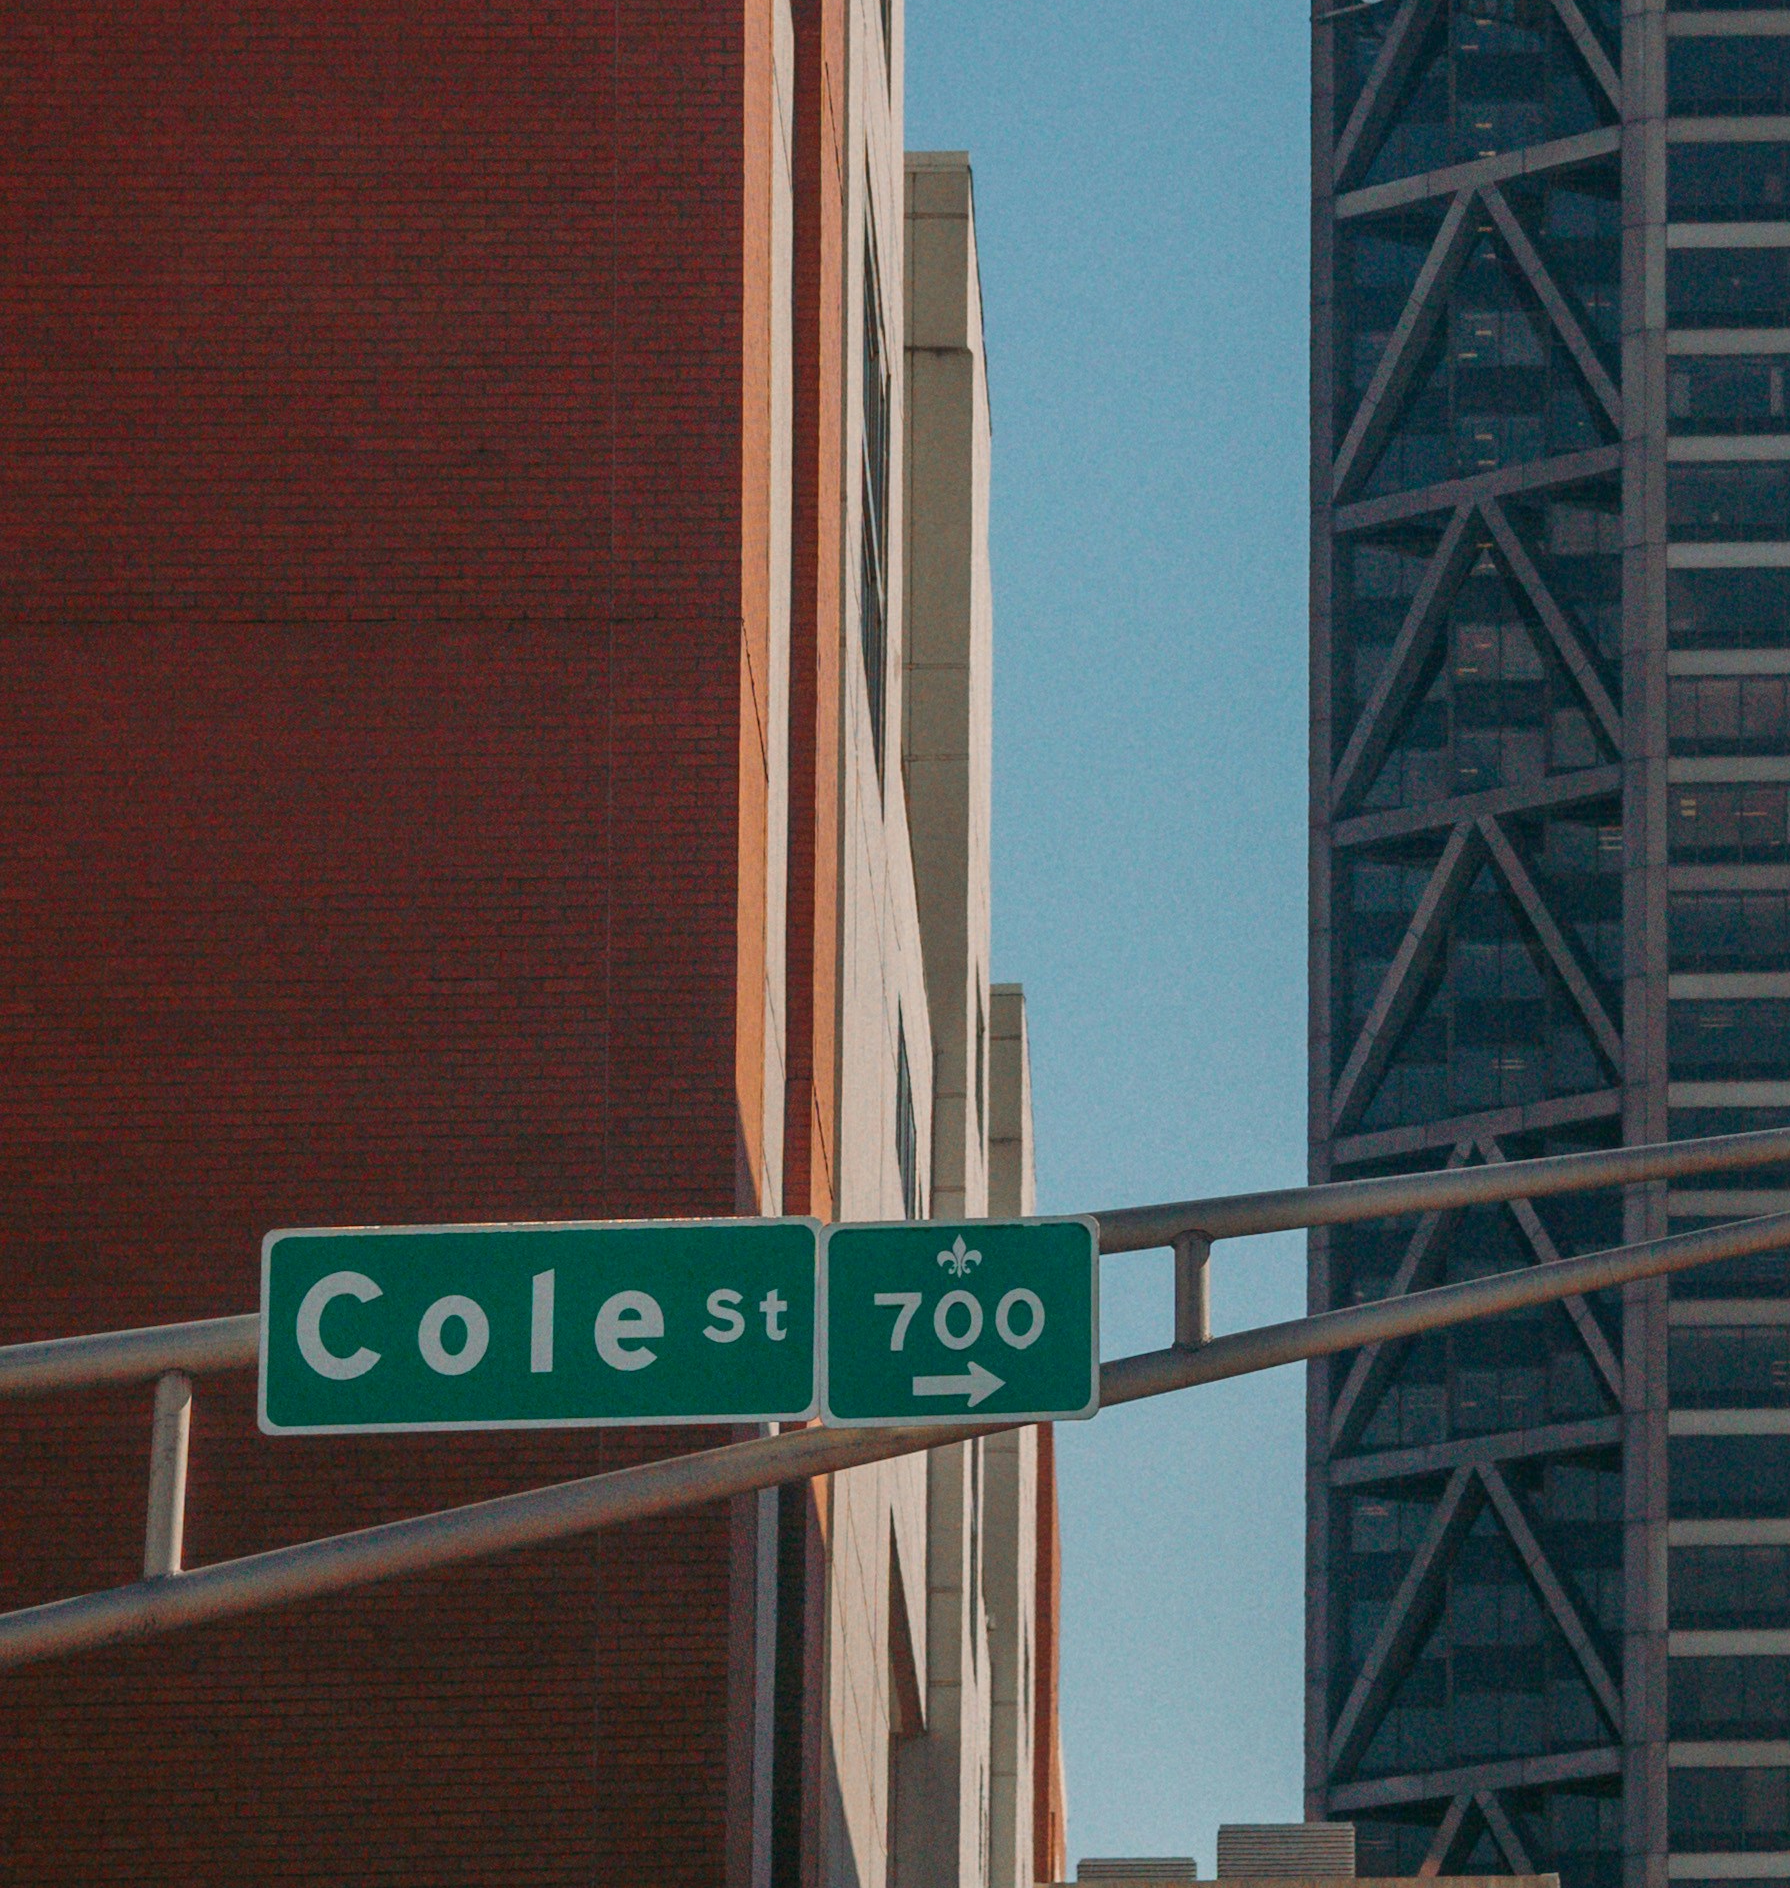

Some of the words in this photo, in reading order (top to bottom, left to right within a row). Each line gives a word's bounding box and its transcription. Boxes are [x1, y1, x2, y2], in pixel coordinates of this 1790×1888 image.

[295, 1267, 666, 1381] Cole
[702, 1286, 790, 1343] St
[872, 1286, 1046, 1353] 700
